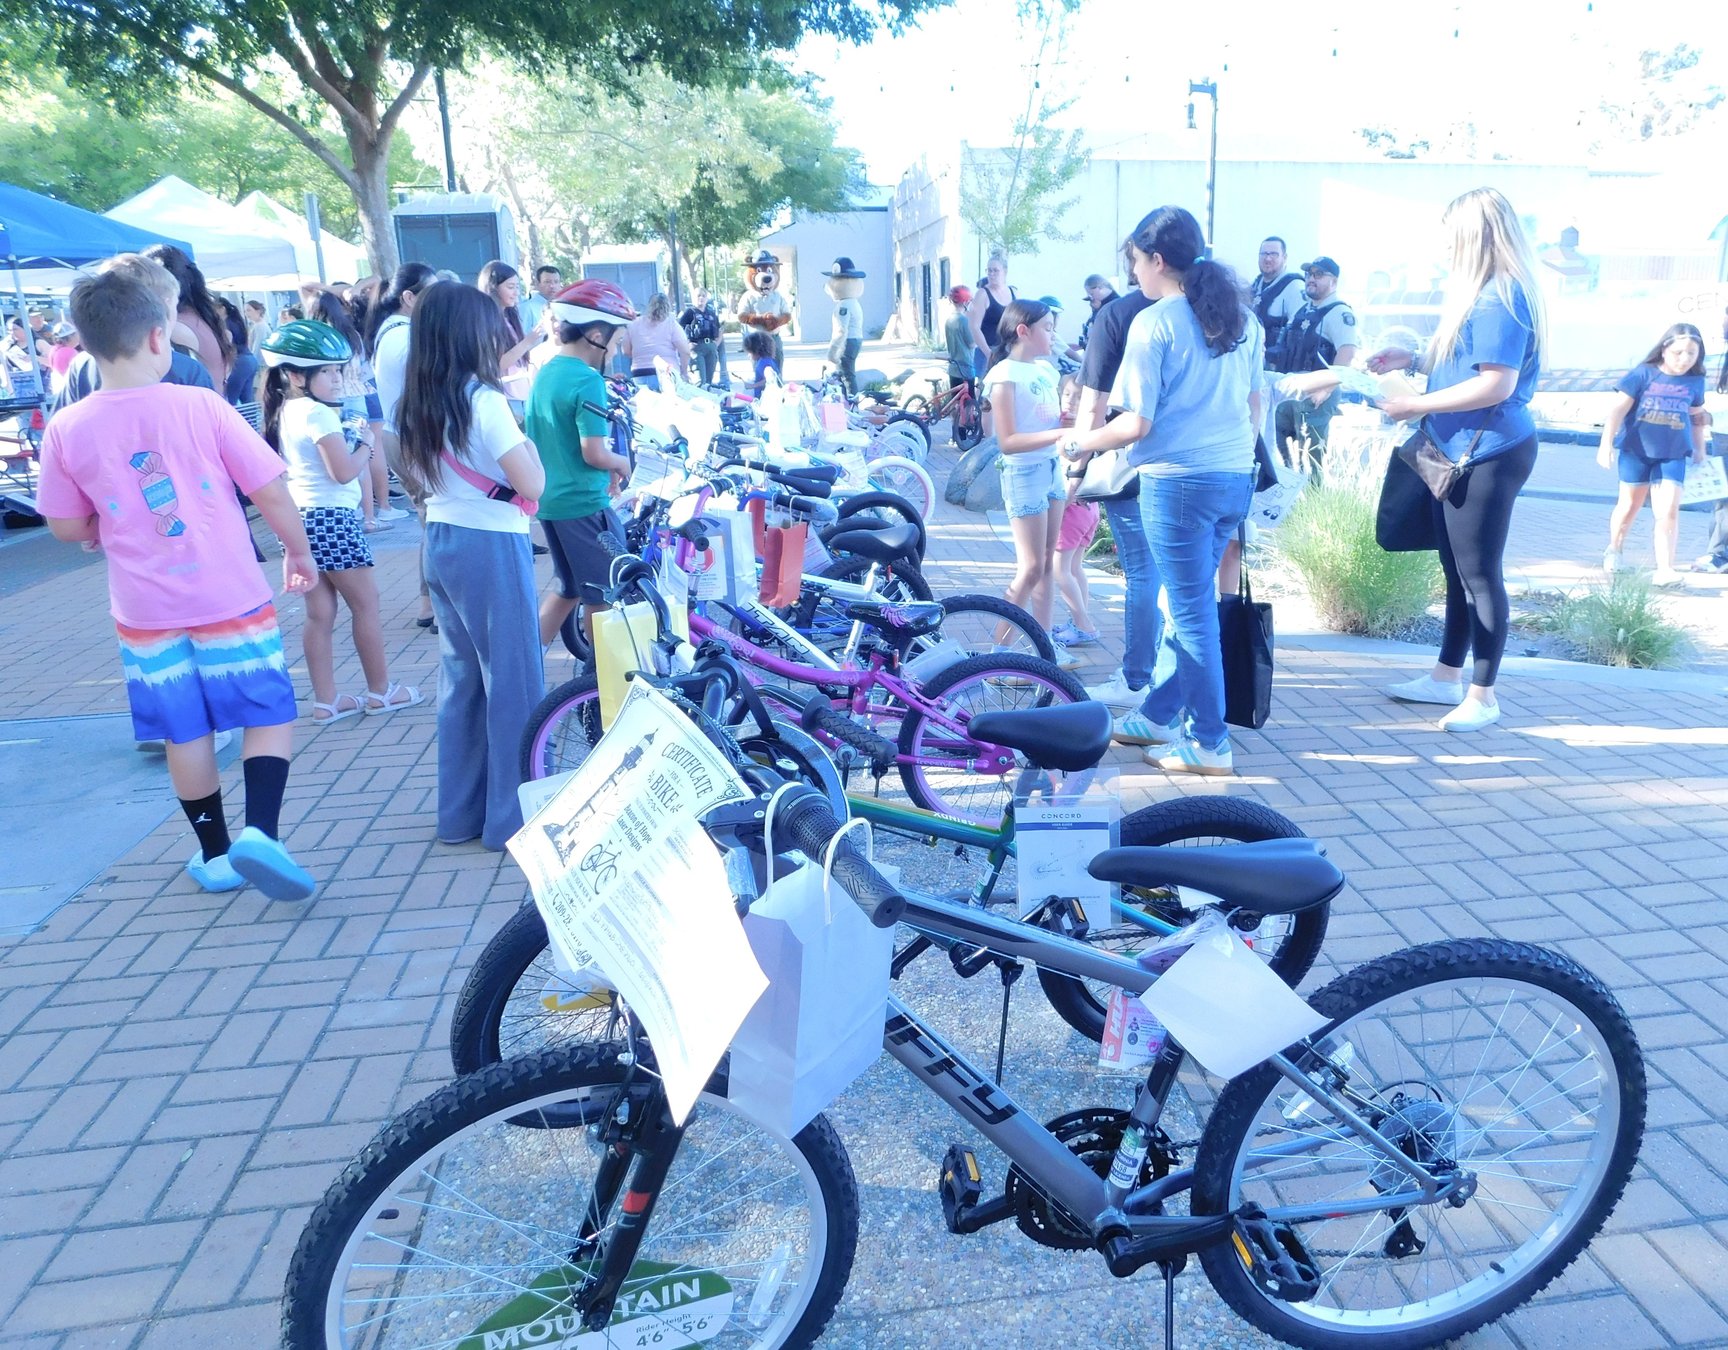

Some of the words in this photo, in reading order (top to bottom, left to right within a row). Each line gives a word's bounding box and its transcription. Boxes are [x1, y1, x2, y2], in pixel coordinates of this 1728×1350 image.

[661, 742, 713, 799] CERTIFICATE
[649, 774, 680, 809] BIKE
[623, 827, 643, 853] Designs
[638, 824, 653, 845] Hope
[483, 1278, 700, 1350] MOUTAIN
[636, 1322, 659, 1334] Rider
[662, 1313, 692, 1329] Height
